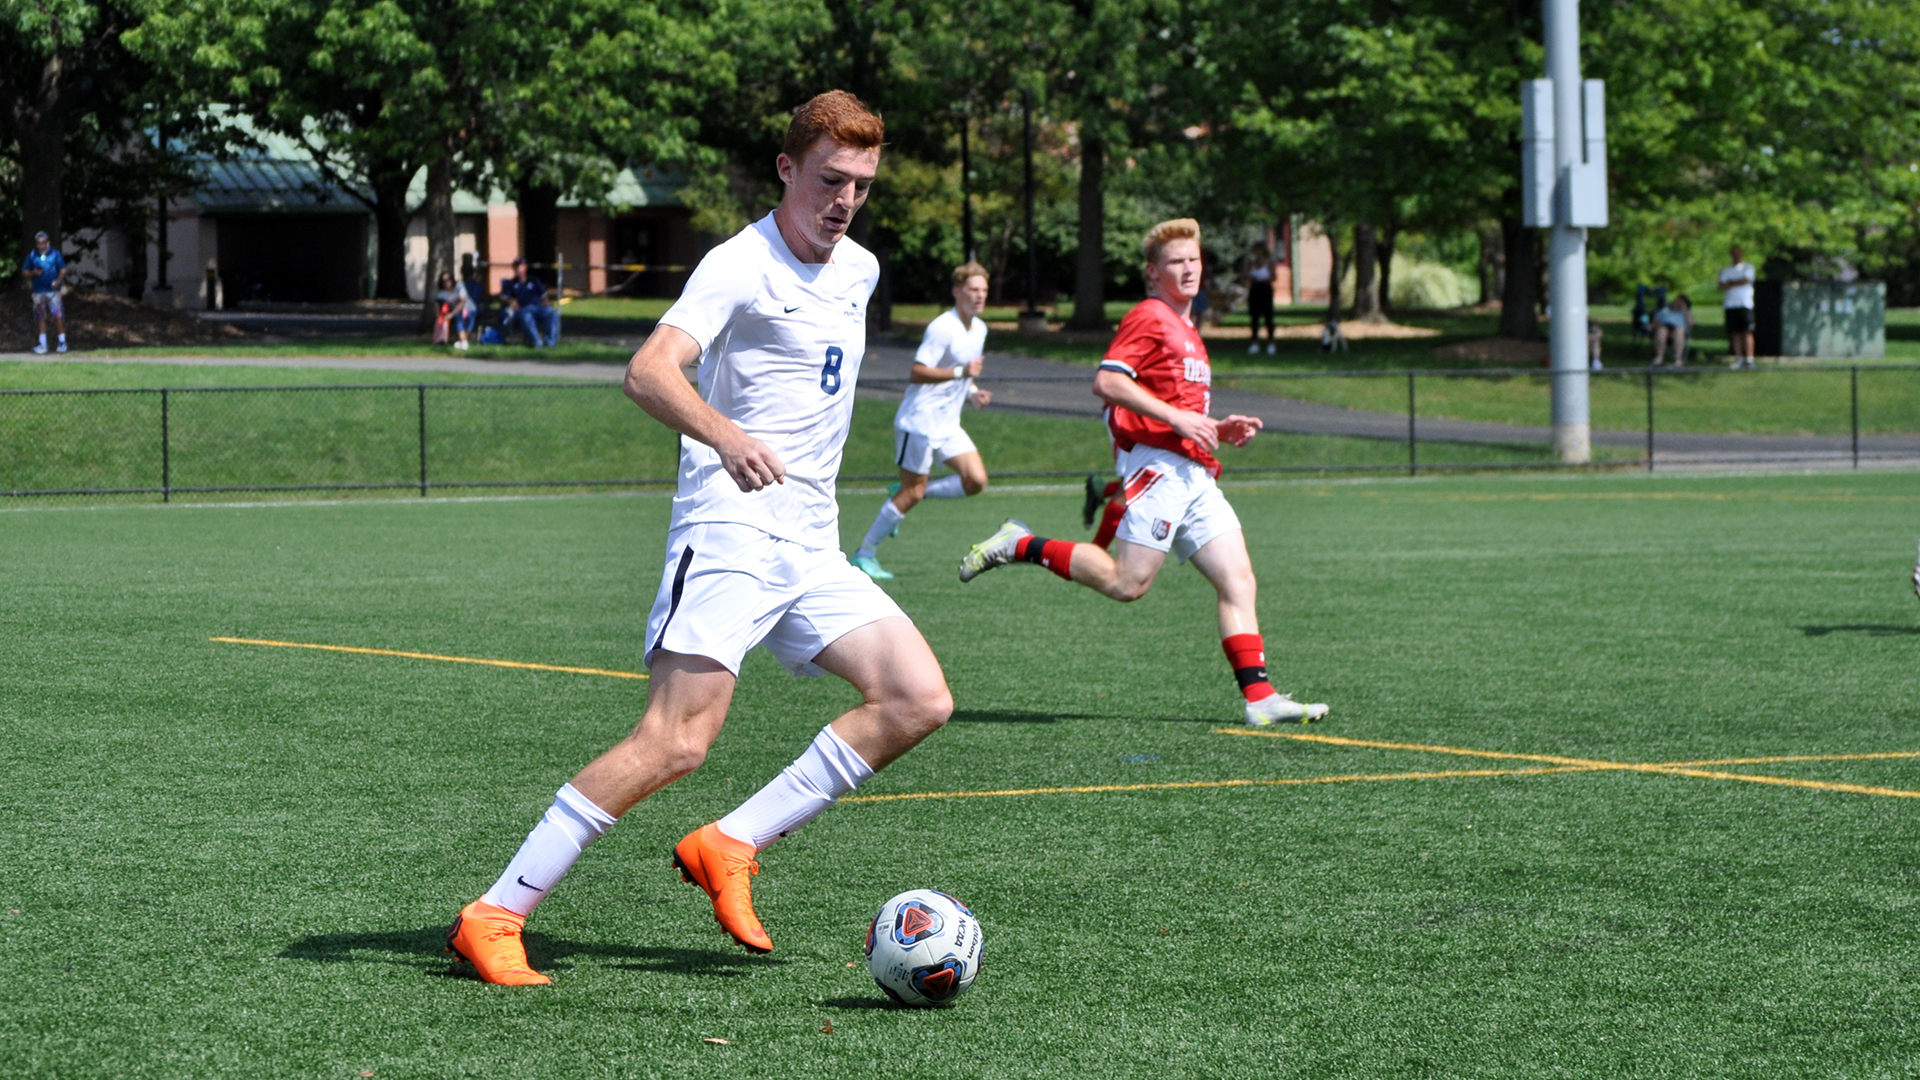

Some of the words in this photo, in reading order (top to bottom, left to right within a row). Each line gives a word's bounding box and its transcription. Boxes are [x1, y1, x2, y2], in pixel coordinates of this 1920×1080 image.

[820, 345, 844, 396] 8
[954, 916, 967, 948] NCAA
[966, 924, 979, 960] Wilson
